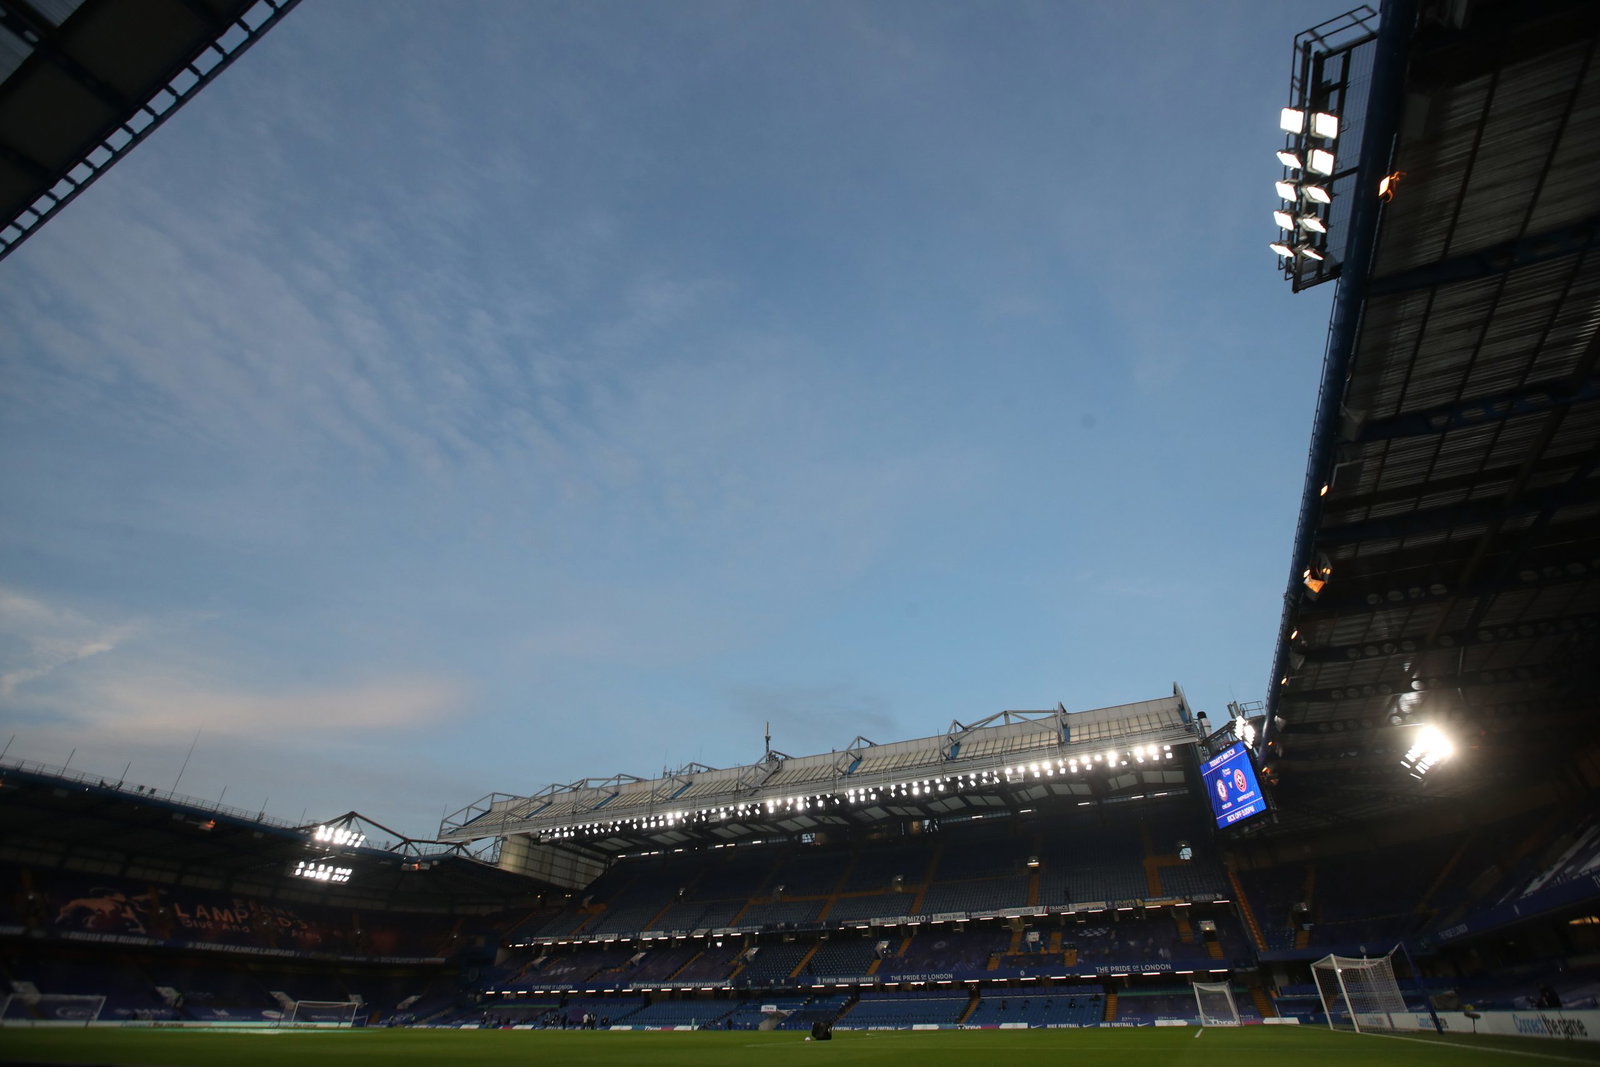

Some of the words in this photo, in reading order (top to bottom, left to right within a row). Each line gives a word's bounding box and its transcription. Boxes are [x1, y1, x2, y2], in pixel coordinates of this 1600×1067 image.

[195, 942, 224, 951] SUPER
[1140, 963, 1171, 971] LONDON
[1512, 1014, 1547, 1034] Connect
